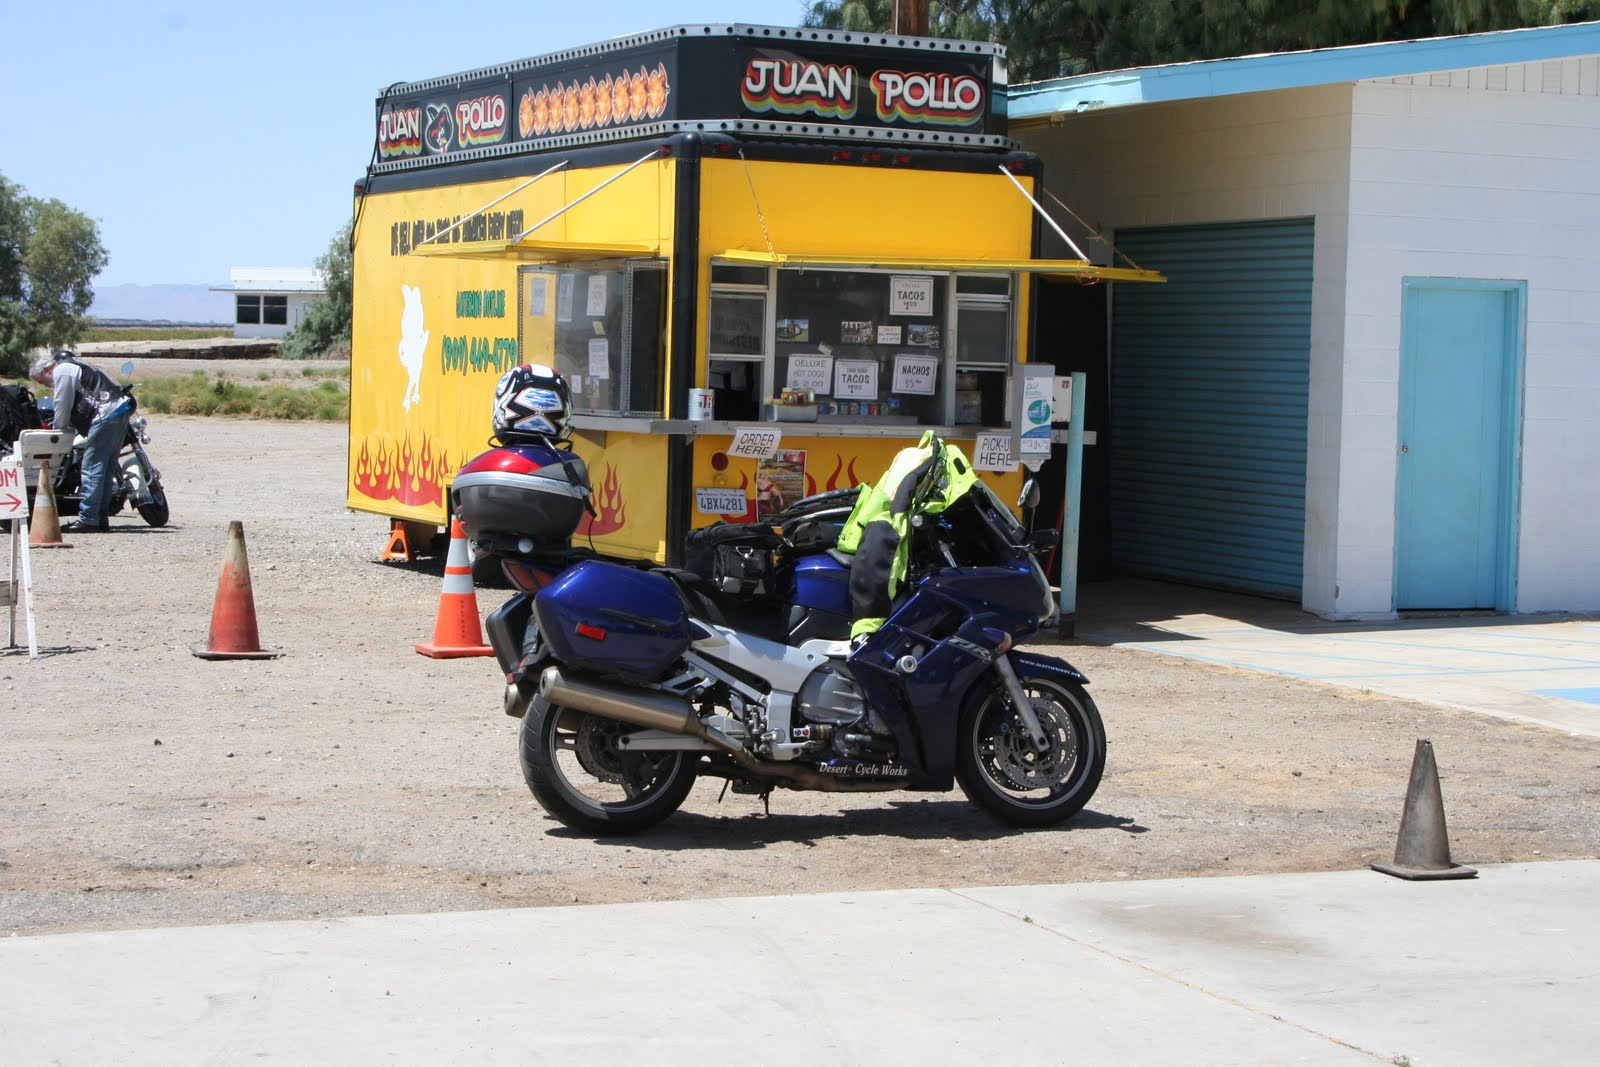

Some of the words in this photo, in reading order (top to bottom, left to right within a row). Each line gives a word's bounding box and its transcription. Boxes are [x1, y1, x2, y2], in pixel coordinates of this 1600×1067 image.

[744, 60, 855, 106] JUAN
[876, 72, 982, 115] POLLO
[379, 108, 420, 146] JUAN
[458, 97, 505, 138] POLLO
[897, 291, 925, 300] TACOS
[441, 335, 468, 376] (909)
[470, 336, 516, 373] 469-4779
[808, 370, 825, 378] DOGS
[902, 365, 930, 376] NACHOS
[842, 374, 870, 384] TACOS
[740, 433, 775, 446] ORDER
[982, 437, 1011, 451] PICK-U
[735, 445, 771, 456] HERE
[980, 453, 1013, 466] HERE
[700, 497, 744, 511] 4BX4281
[819, 762, 848, 774] Desert
[855, 763, 879, 776] Cycle
[882, 764, 908, 776] Works
